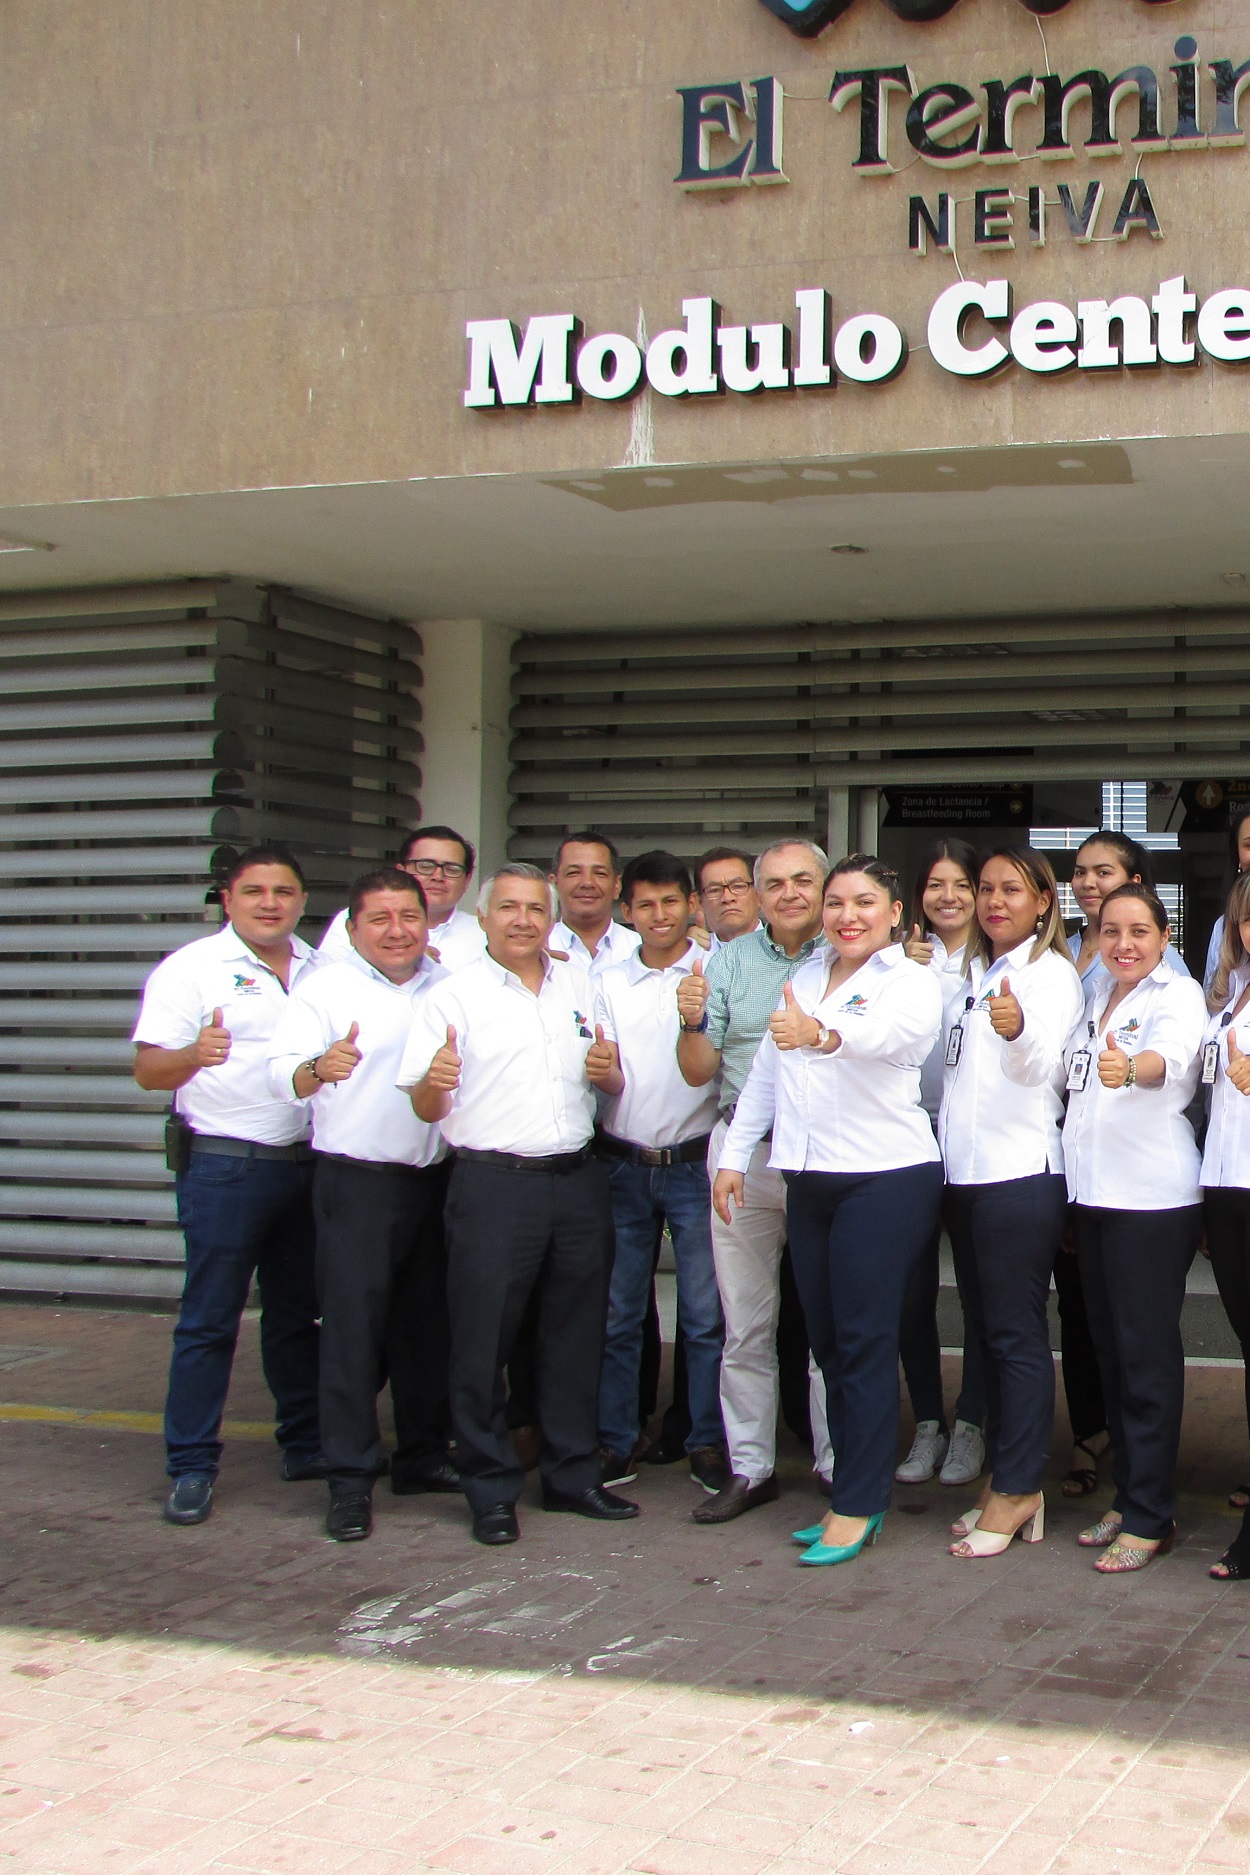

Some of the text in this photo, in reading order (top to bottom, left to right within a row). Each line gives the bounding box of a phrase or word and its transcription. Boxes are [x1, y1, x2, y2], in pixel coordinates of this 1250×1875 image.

[674, 74, 788, 189] El
[908, 178, 1163, 255] NEIVA
[464, 287, 908, 408] Modulo
[902, 797, 923, 806] Zona
[926, 797, 937, 806] de
[939, 797, 982, 806] Lactancia
[902, 809, 990, 820] Breastfeeding Room
